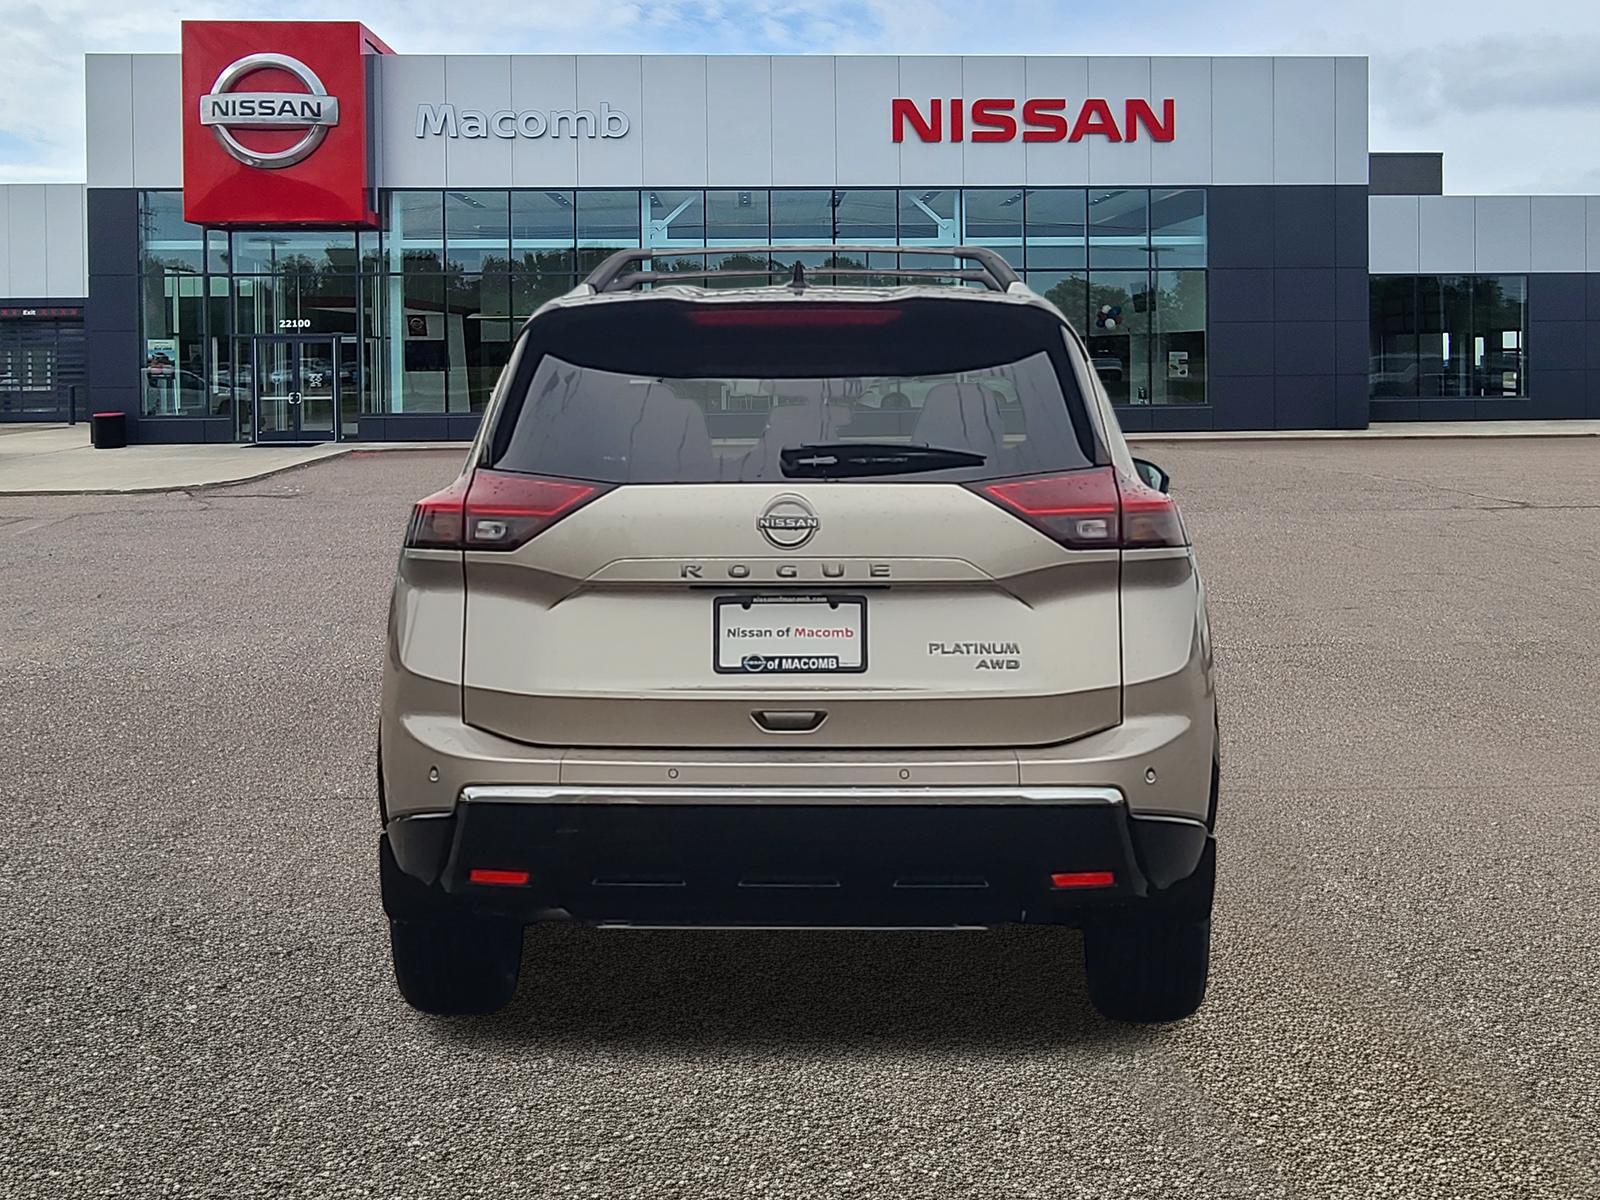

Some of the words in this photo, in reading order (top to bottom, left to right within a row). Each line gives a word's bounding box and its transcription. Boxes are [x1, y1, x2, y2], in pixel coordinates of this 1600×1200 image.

[211, 100, 322, 117] NISSAN
[415, 102, 630, 139] Macomb
[892, 98, 1175, 142] NISSAN
[279, 319, 311, 328] 22100
[760, 517, 817, 529] NISSAN
[680, 563, 891, 579] ROGUE
[726, 627, 773, 638] Nissan
[776, 626, 791, 638] of
[794, 626, 854, 638] Macomb
[928, 642, 1021, 655] PLATINUM
[767, 658, 780, 670] of
[782, 658, 837, 670] MACOMB
[975, 659, 1021, 670] AWD
